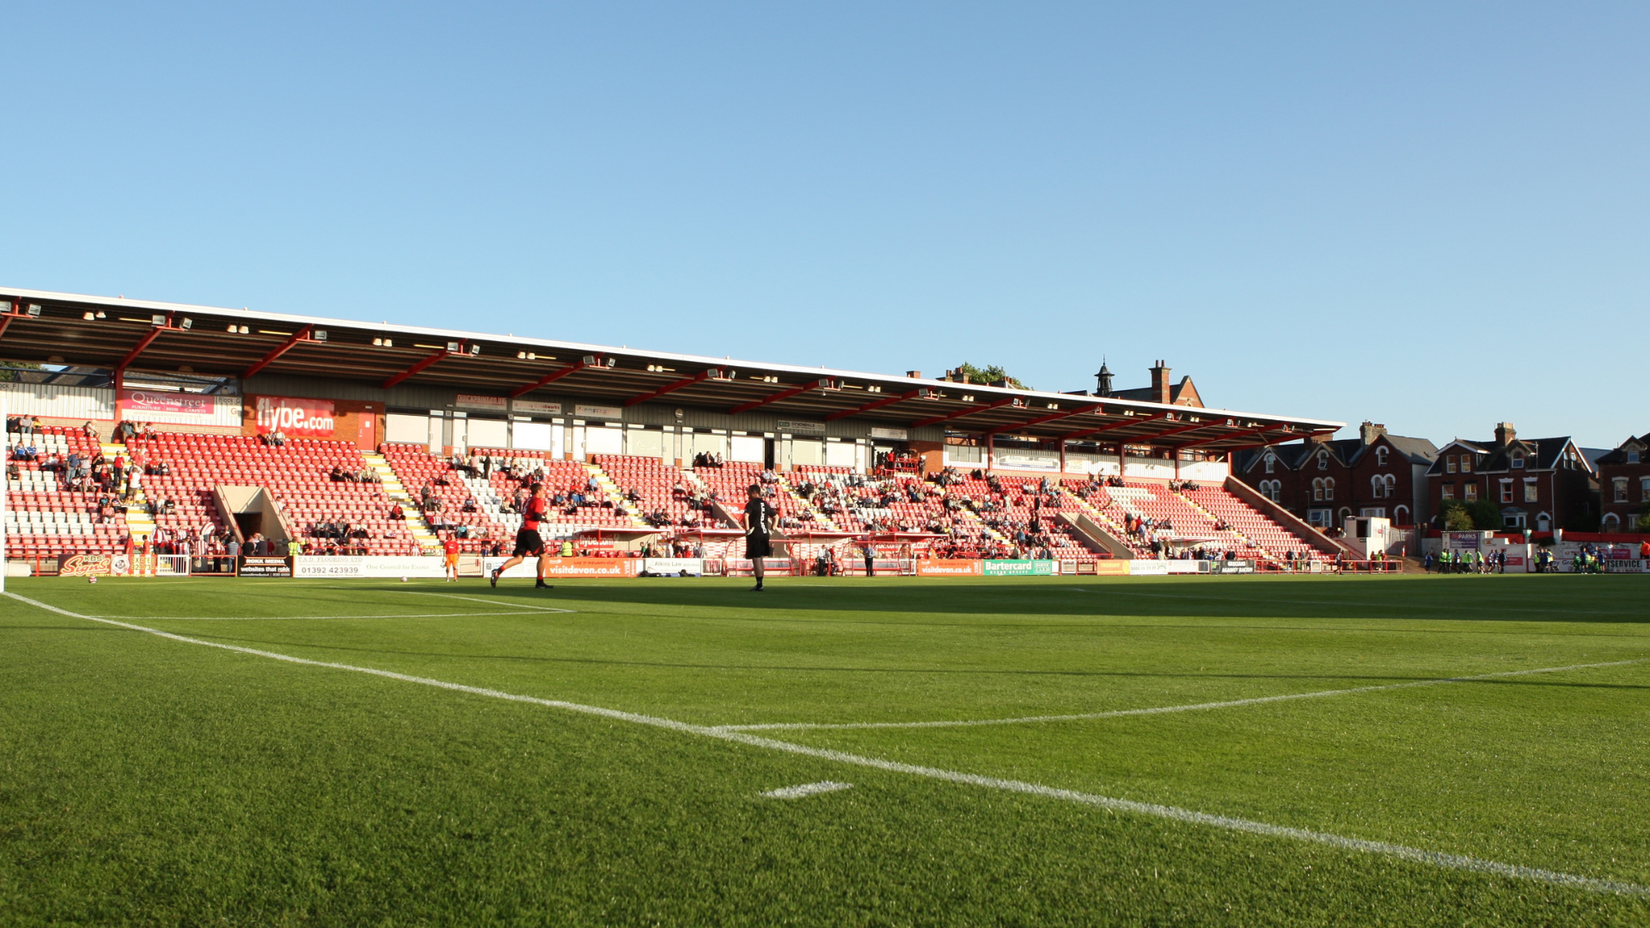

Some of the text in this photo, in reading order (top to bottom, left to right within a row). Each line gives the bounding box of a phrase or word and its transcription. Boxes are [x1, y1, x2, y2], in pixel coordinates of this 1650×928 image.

[131, 391, 206, 408] Queenstreet
[257, 398, 334, 432] flybe.com
[60, 555, 111, 576] Signs
[549, 564, 621, 574] visitdevon.co.uk
[921, 566, 972, 574] visitdevon.co.uk
[985, 560, 1032, 570] Bartercard
